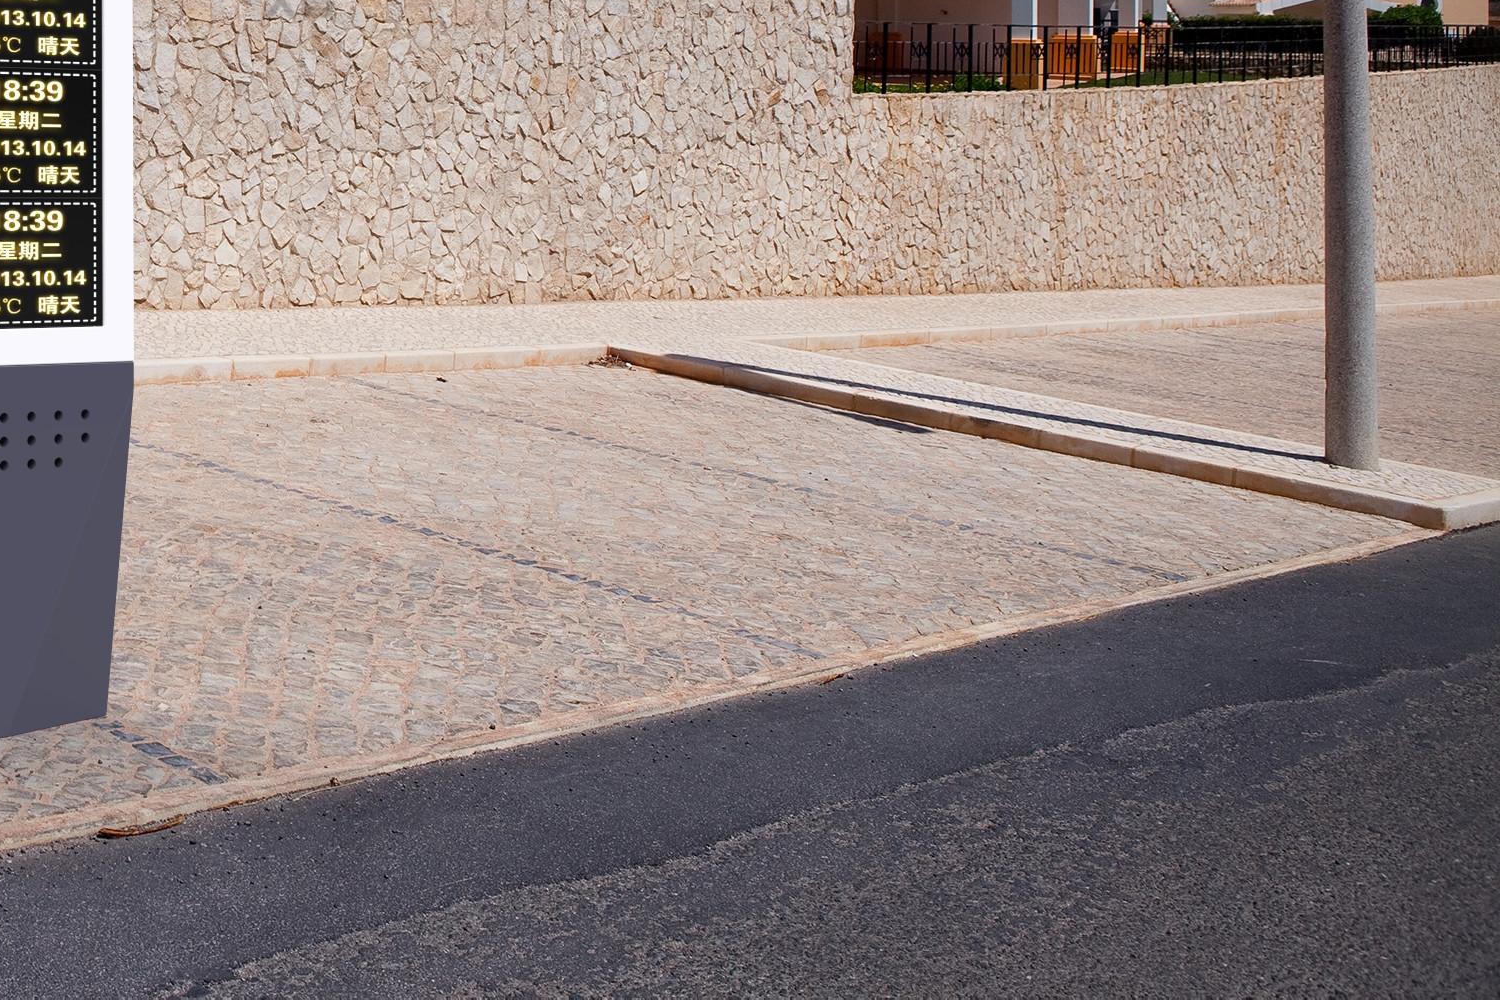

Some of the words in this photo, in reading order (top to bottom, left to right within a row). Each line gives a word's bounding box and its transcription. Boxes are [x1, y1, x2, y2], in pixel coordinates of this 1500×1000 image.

[39, 36, 79, 55] 晴天
[39, 165, 79, 184] 晴天
[39, 295, 80, 314] 晴天
